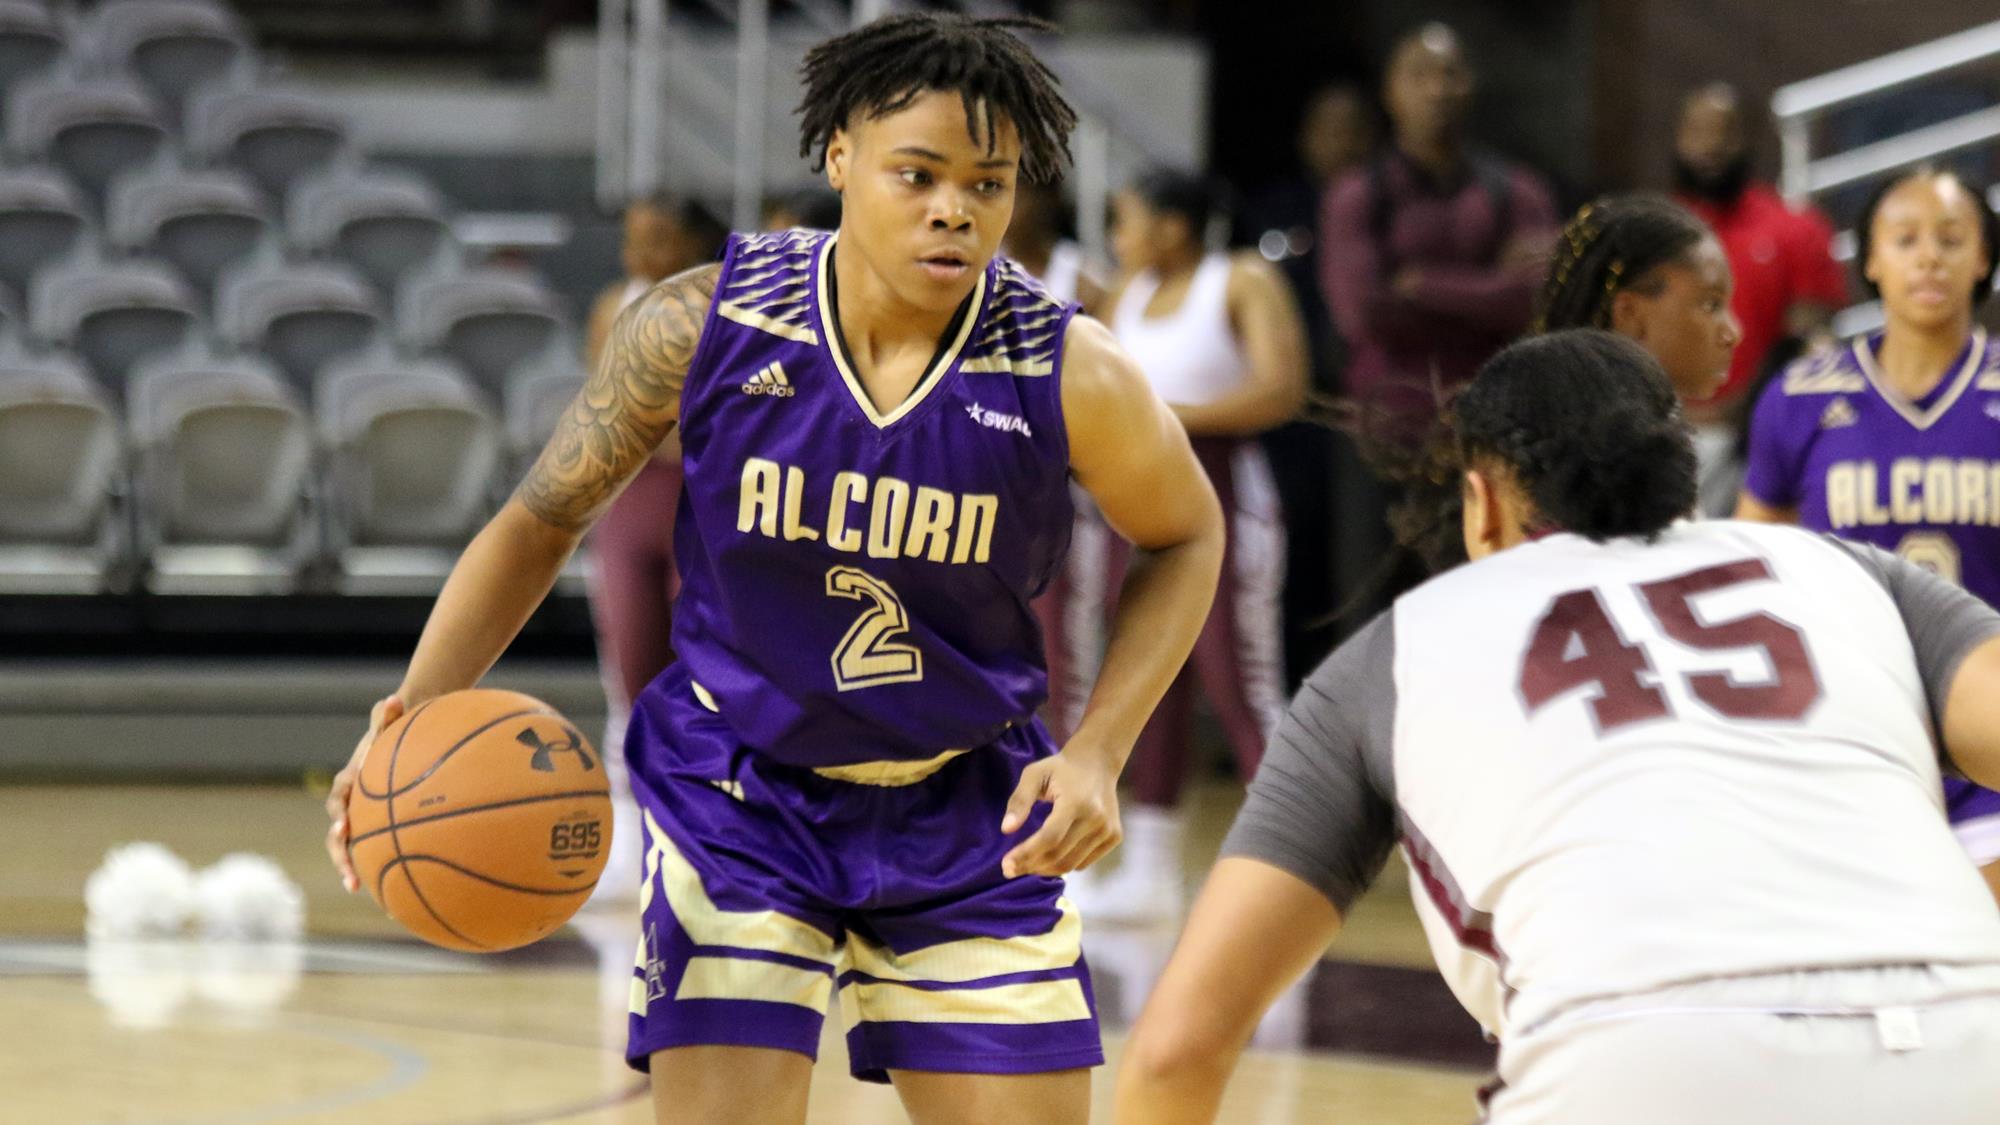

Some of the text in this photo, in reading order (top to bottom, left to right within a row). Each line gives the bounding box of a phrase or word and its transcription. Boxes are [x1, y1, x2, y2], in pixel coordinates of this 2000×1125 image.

[741, 383, 795, 397] adidas
[736, 457, 999, 565] ALCORN
[825, 565, 923, 692] 2
[1515, 556, 1824, 737] 45
[551, 820, 601, 850] 695
